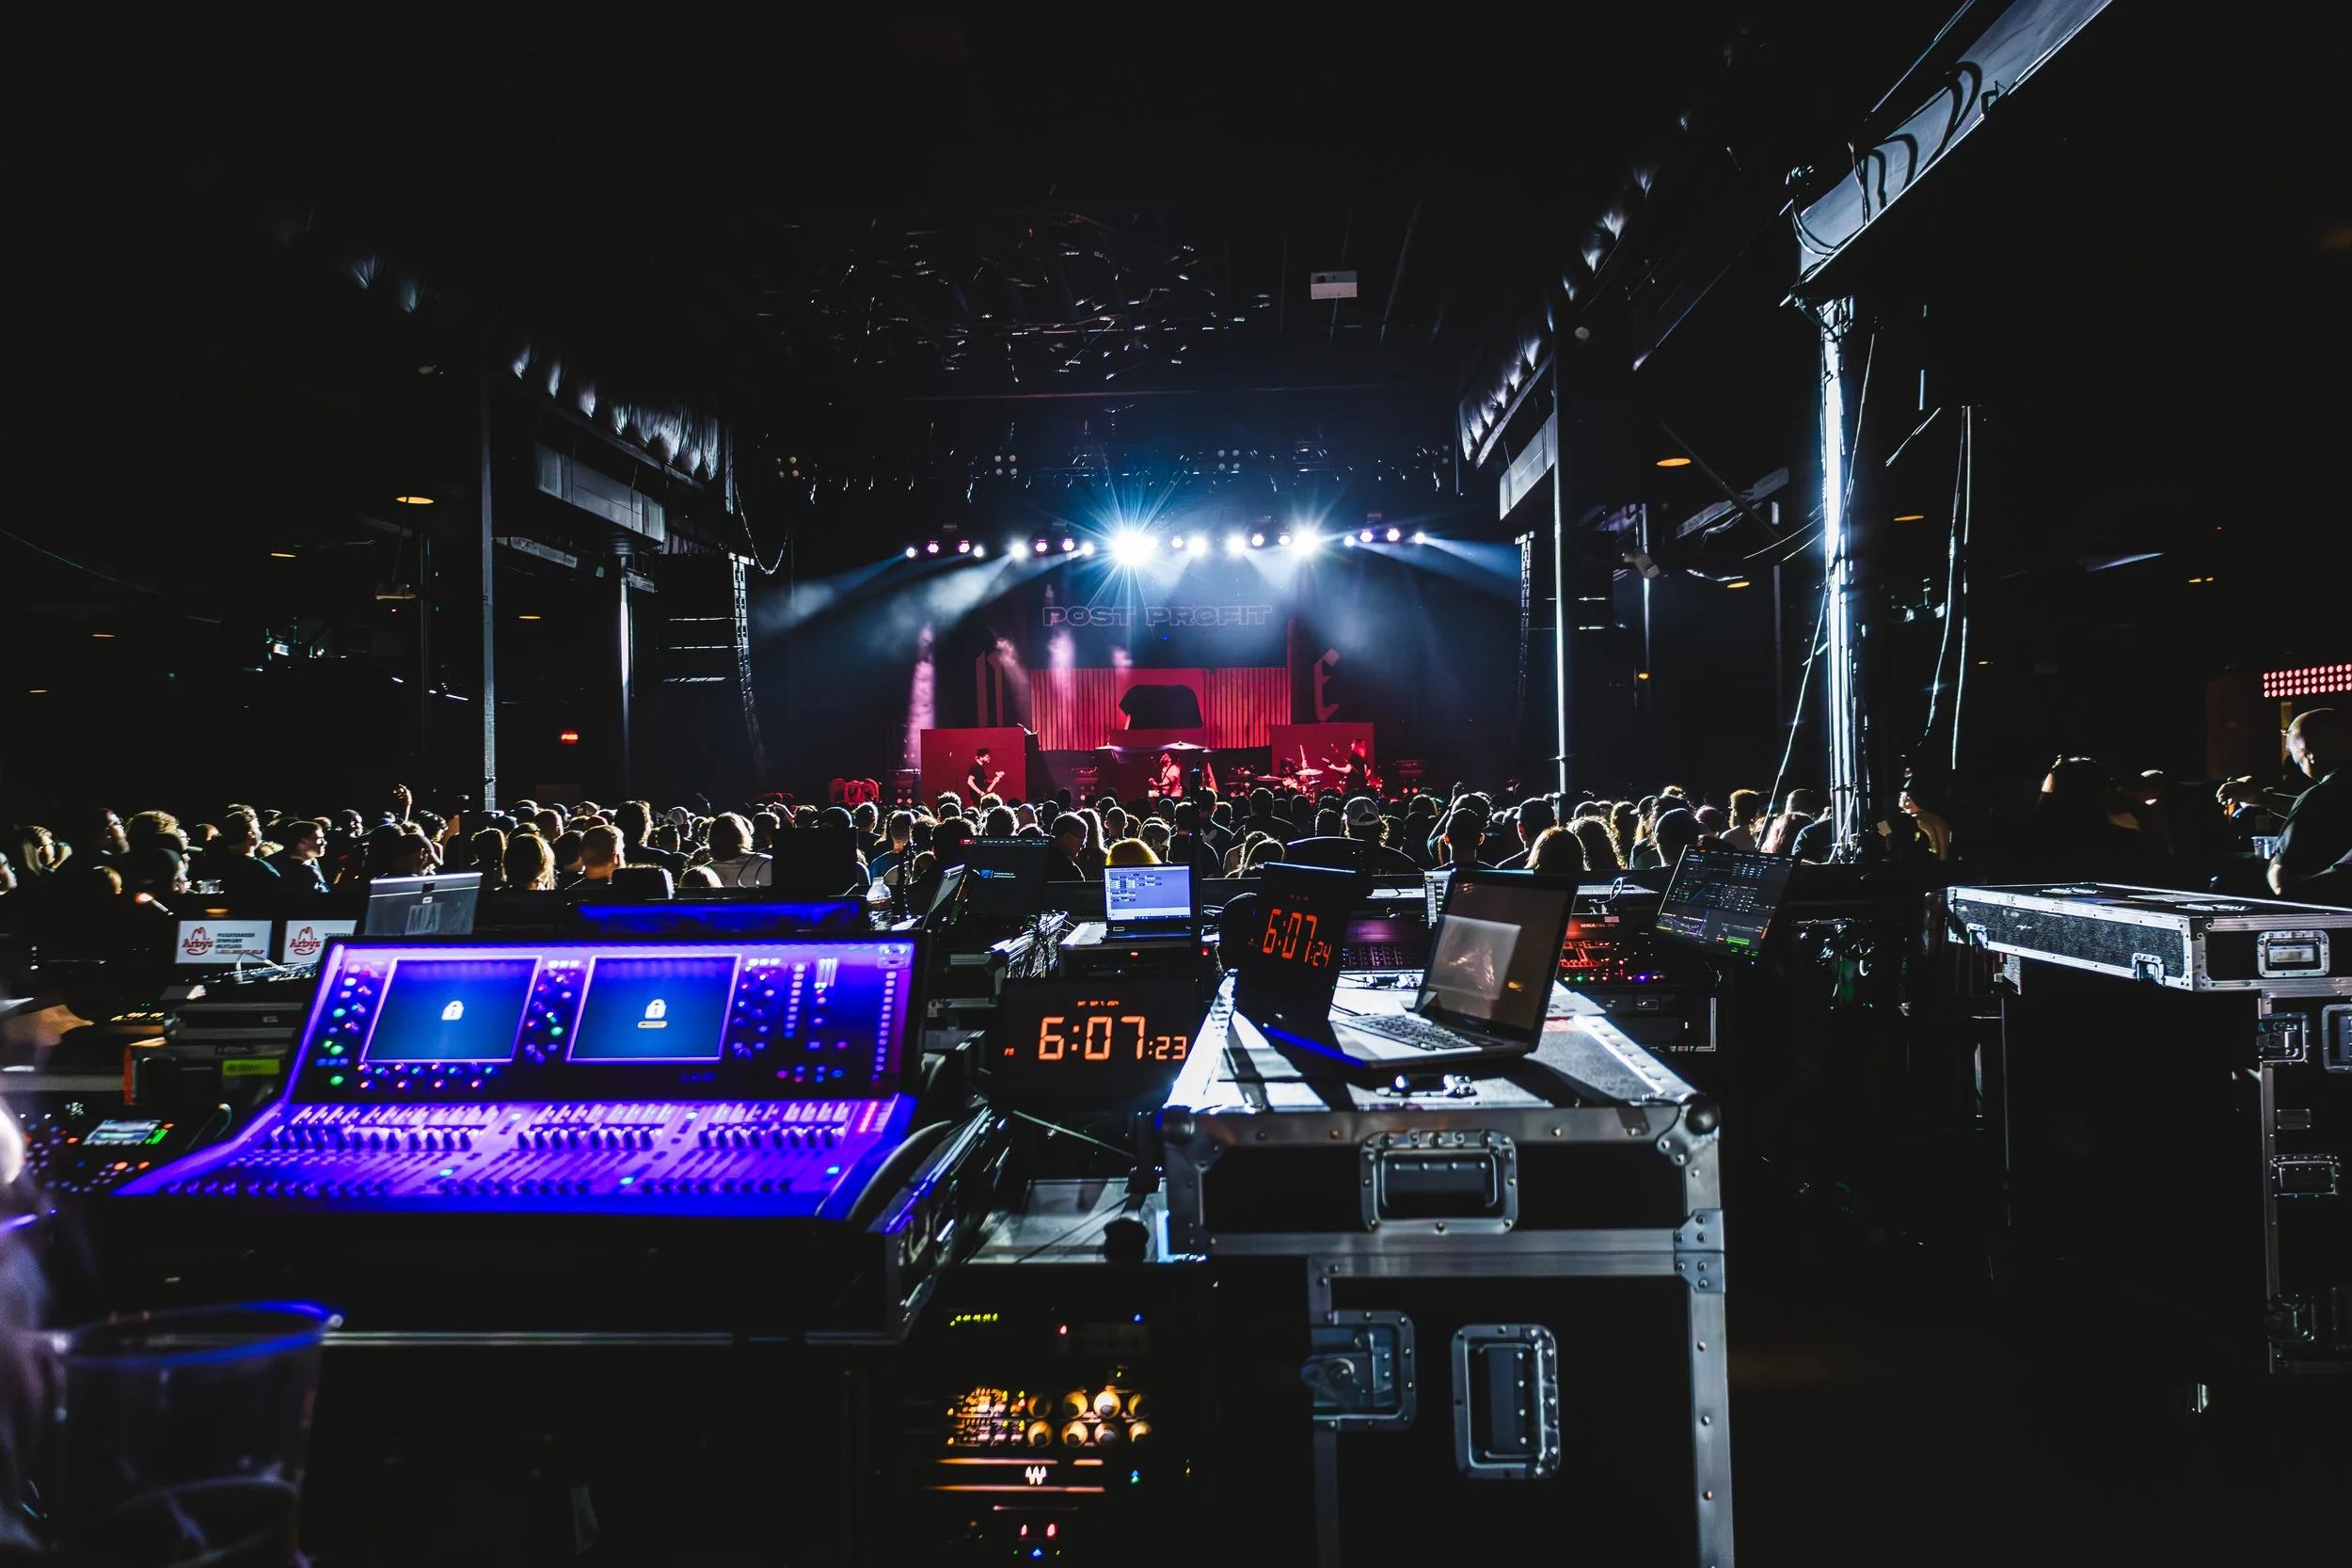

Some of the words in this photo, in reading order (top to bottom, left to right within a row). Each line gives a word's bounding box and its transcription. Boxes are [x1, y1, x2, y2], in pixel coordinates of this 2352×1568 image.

[1042, 606, 1136, 626] POST
[1145, 606, 1272, 626] PROFIT
[182, 938, 214, 951] Arby's
[289, 938, 322, 951] Arby's
[1262, 908, 1332, 968] 6:07:24
[1039, 1015, 1188, 1060] 6:07:23
